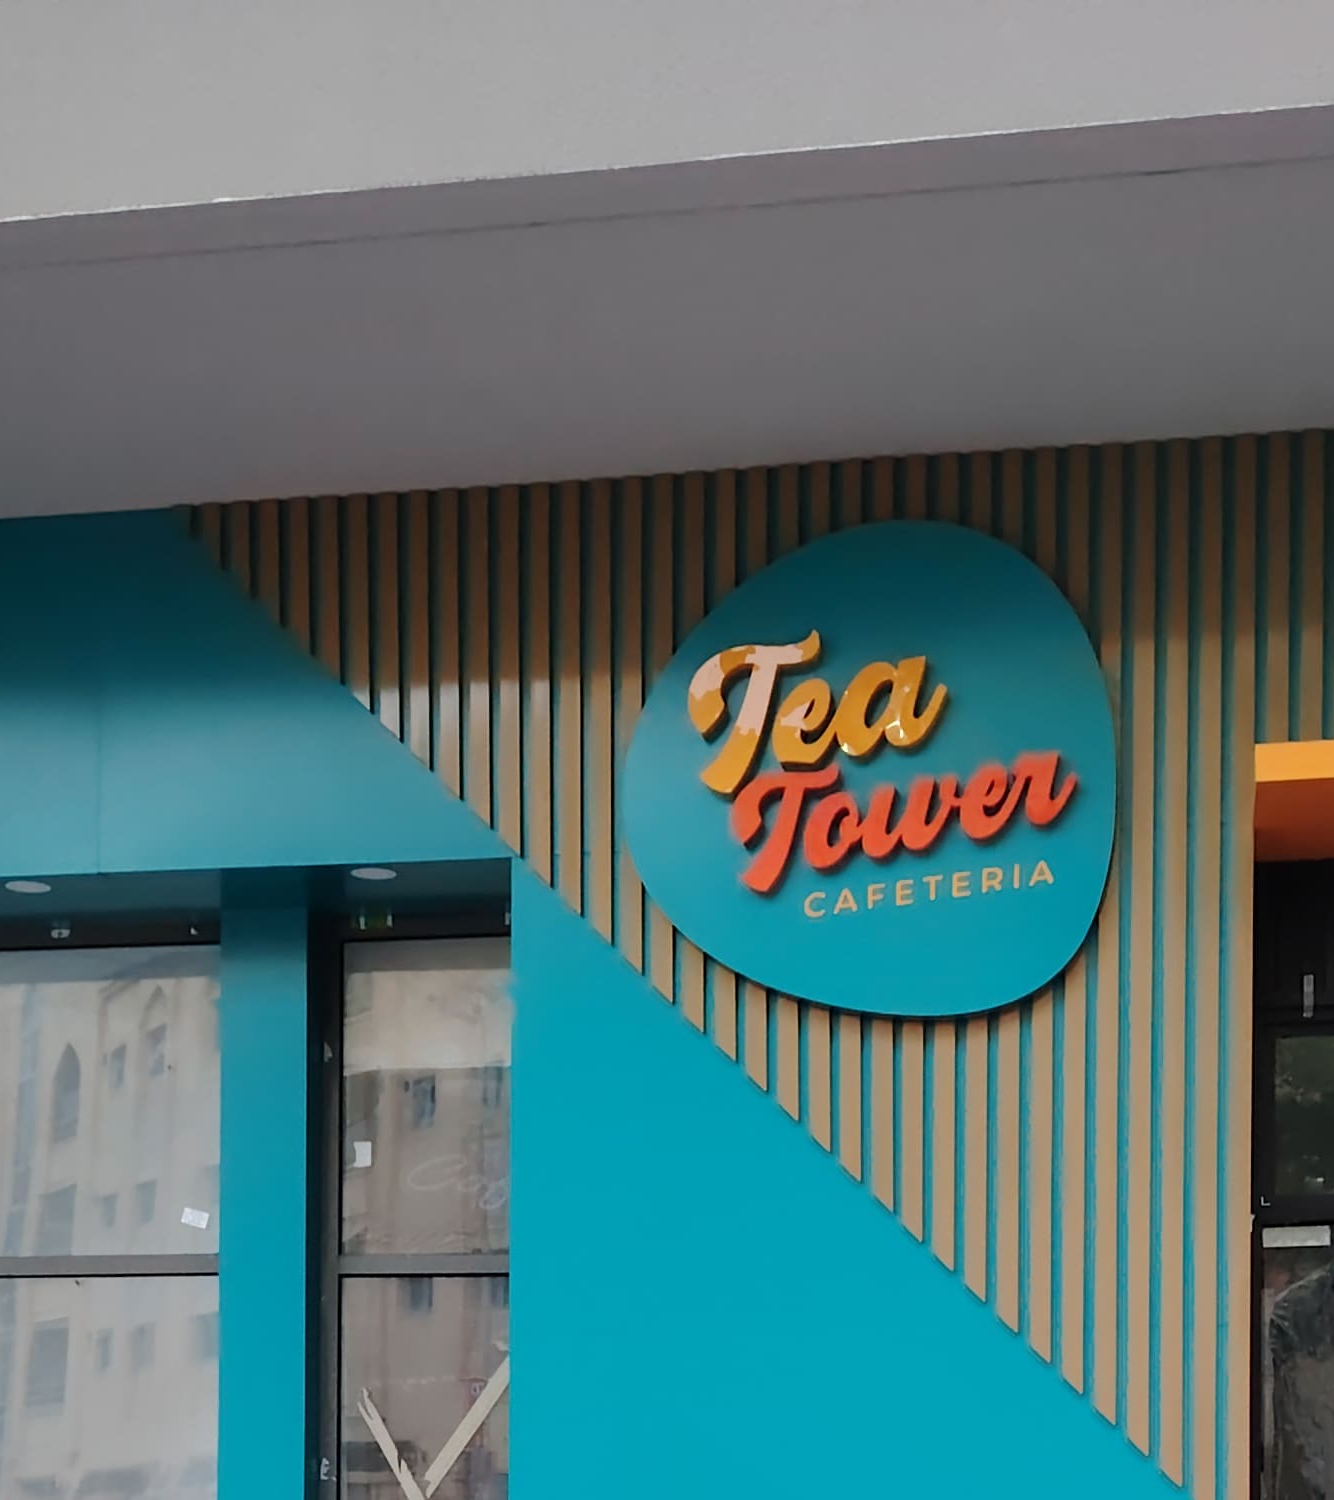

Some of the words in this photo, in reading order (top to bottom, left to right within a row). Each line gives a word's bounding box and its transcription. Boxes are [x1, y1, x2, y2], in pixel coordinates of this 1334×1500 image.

[687, 628, 948, 795] Tea
[729, 750, 1078, 894] Tower
[803, 859, 1054, 919] CAFETERIA
